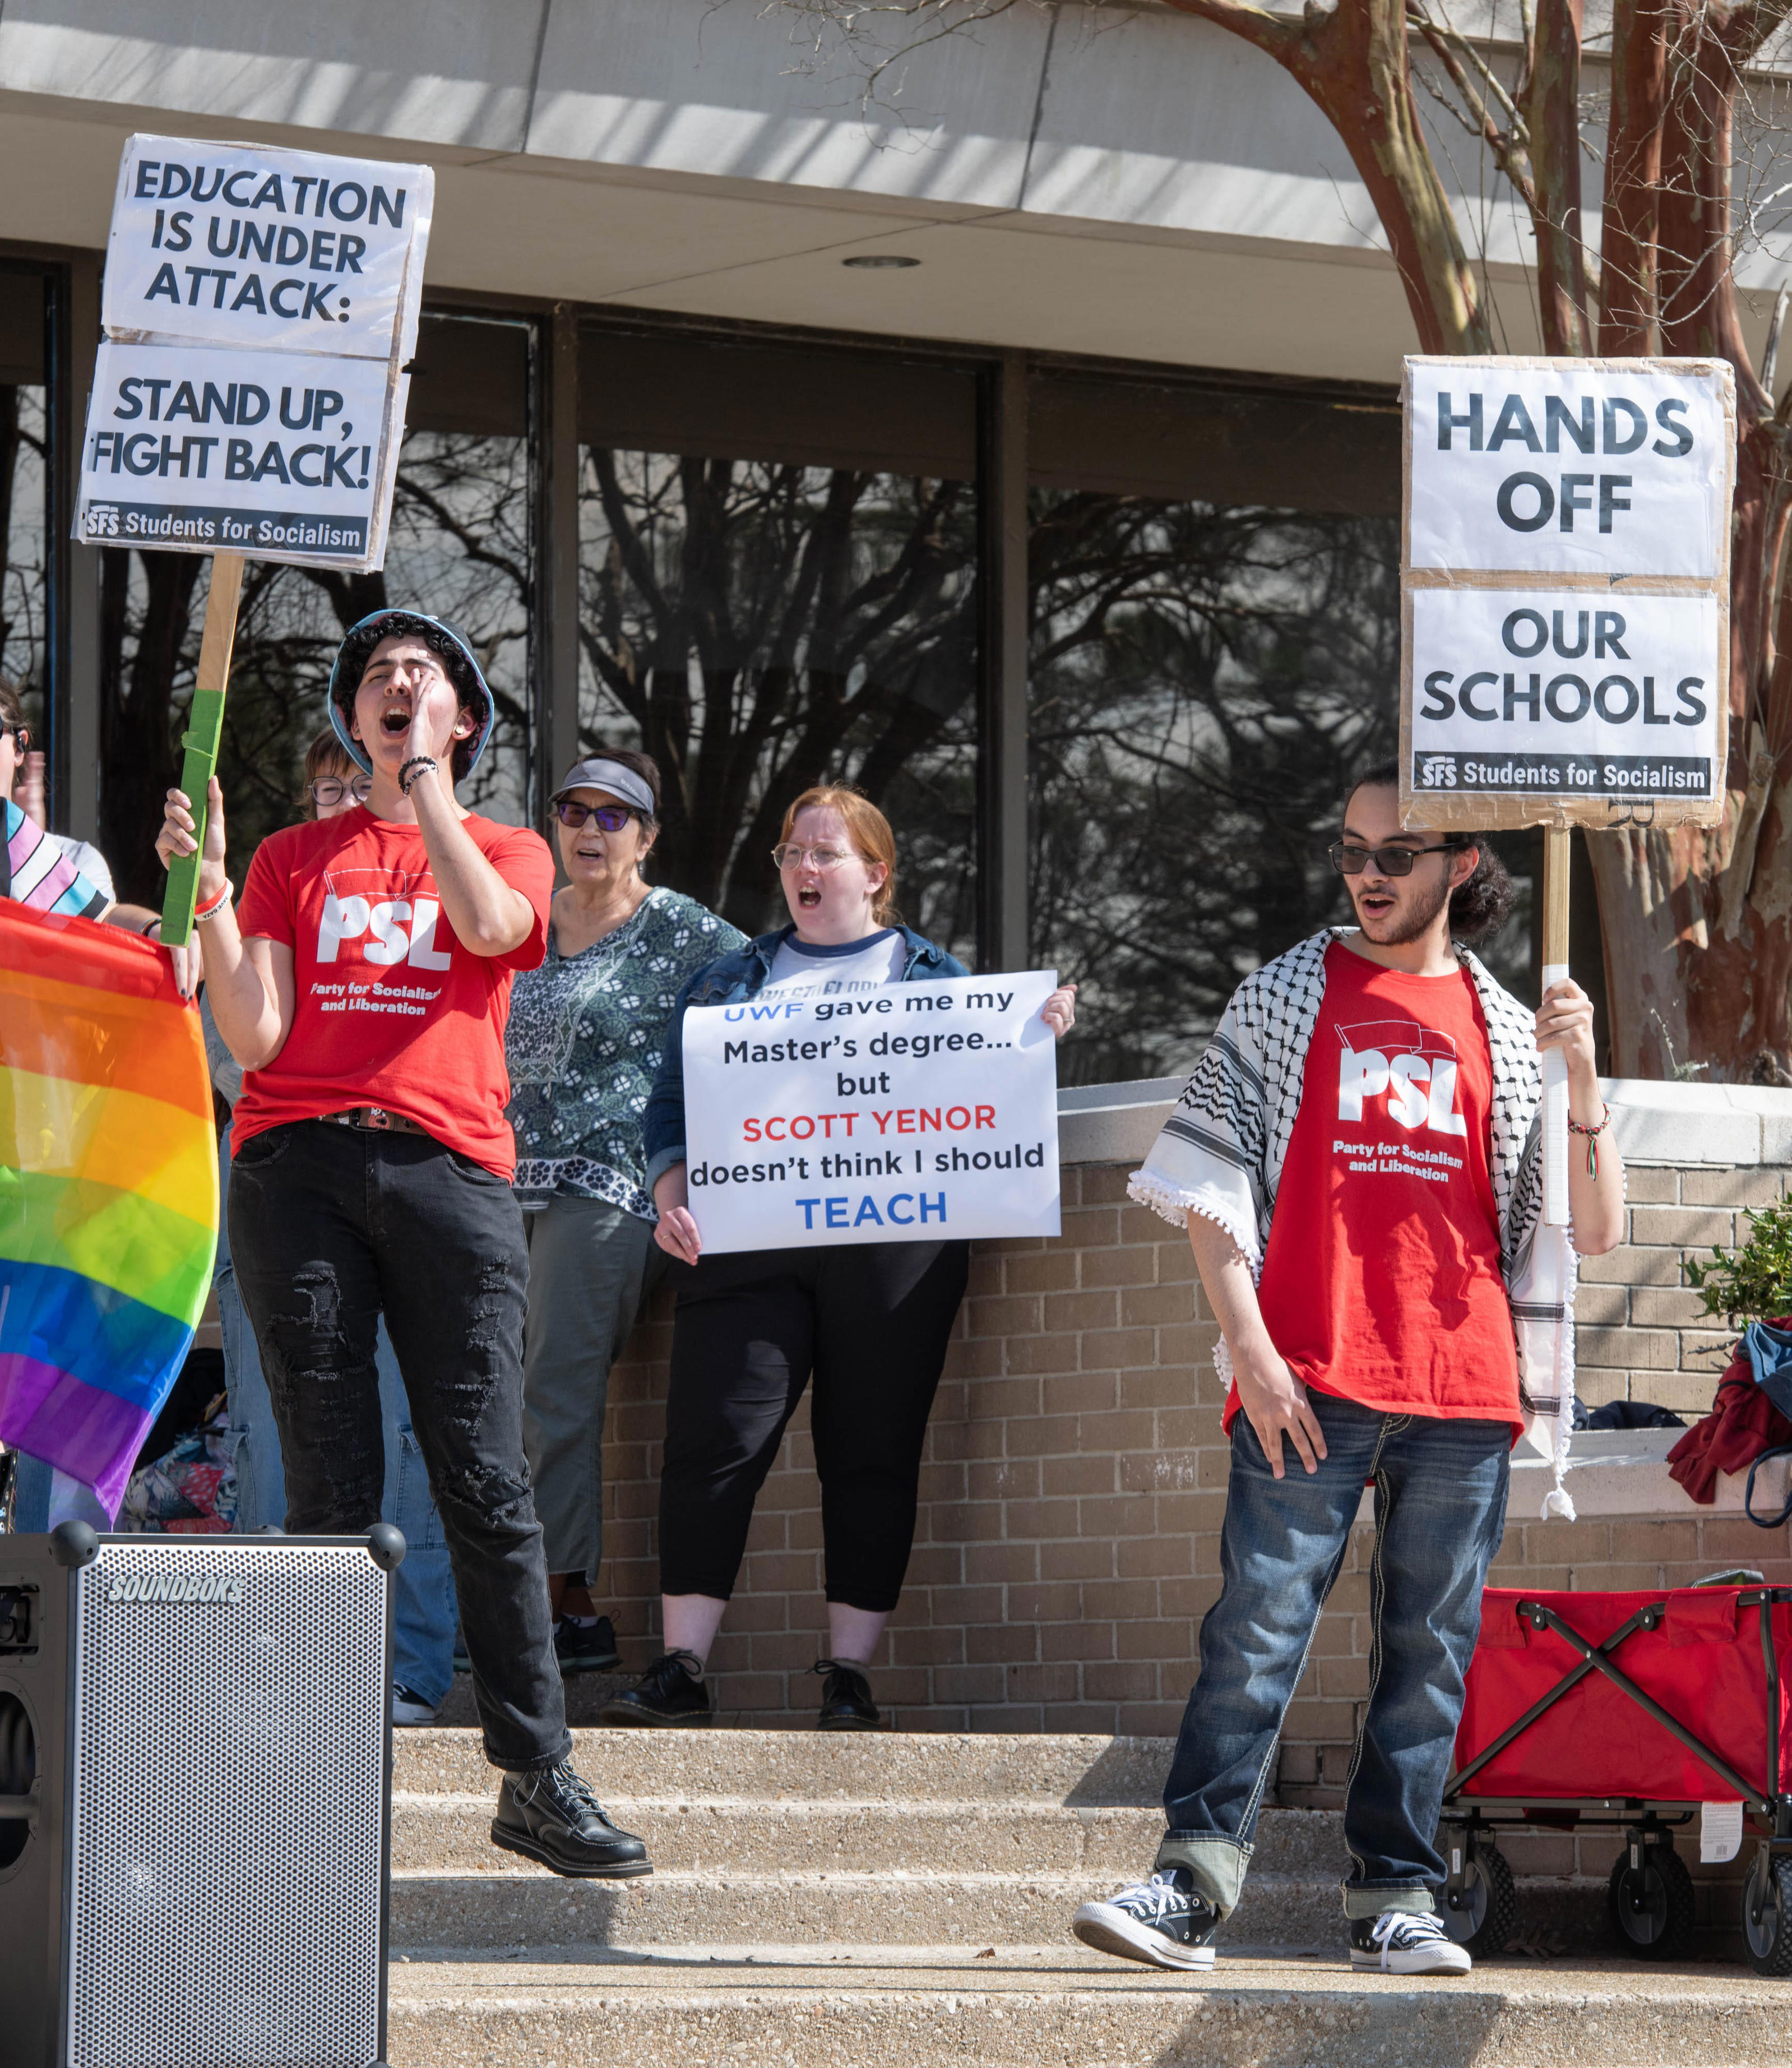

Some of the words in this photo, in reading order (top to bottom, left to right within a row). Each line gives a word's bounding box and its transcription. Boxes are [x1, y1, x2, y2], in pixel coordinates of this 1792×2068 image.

[135, 160, 406, 228] EDUCATION
[151, 209, 194, 252] IS
[207, 217, 366, 274] UNDER
[144, 263, 351, 323] ATTACK:
[113, 377, 271, 425] STAND
[279, 387, 354, 440] UP,
[1438, 391, 1694, 457] HANDS
[91, 432, 219, 478] FIGHT
[225, 441, 371, 490] BACK!
[1497, 471, 1633, 534] OFF
[87, 512, 119, 535] SFS
[126, 512, 215, 537] Students
[222, 516, 252, 539] for
[258, 520, 360, 547] Socialism
[1502, 608, 1632, 660] OUR
[1420, 671, 1707, 726] SCHOOLS
[1422, 763, 1457, 787] SFS
[1464, 762, 1561, 785] Students
[1567, 762, 1597, 786] for
[1604, 764, 1705, 788] Socialism
[202, 908, 218, 919] GAZA
[316, 894, 451, 971] PSL
[310, 982, 346, 997] Party
[348, 982, 370, 994] for
[321, 998, 346, 1011] and
[348, 998, 426, 1015] Liberation
[724, 1002, 804, 1022] UWF
[814, 1000, 893, 1021] gave
[905, 995, 953, 1012] me
[966, 992, 1015, 1012] my
[724, 1035, 858, 1064] Master's
[869, 1031, 1011, 1058] degree...
[837, 1072, 890, 1097] but
[1339, 1048, 1467, 1137] PSL
[743, 1112, 859, 1143] SCOTT
[872, 1104, 996, 1136] YENOR
[690, 1156, 809, 1187] doesn't
[821, 1149, 903, 1179] think
[915, 1150, 922, 1173] I
[934, 1142, 1044, 1173] should
[1333, 1140, 1374, 1158] Party
[1377, 1141, 1400, 1155] for
[1402, 1144, 1462, 1169] Socialism
[1349, 1159, 1377, 1172] and
[1379, 1159, 1449, 1183] Liberation
[795, 1191, 947, 1230] TEACH
[109, 1576, 246, 1603] SOUNDBOKS
